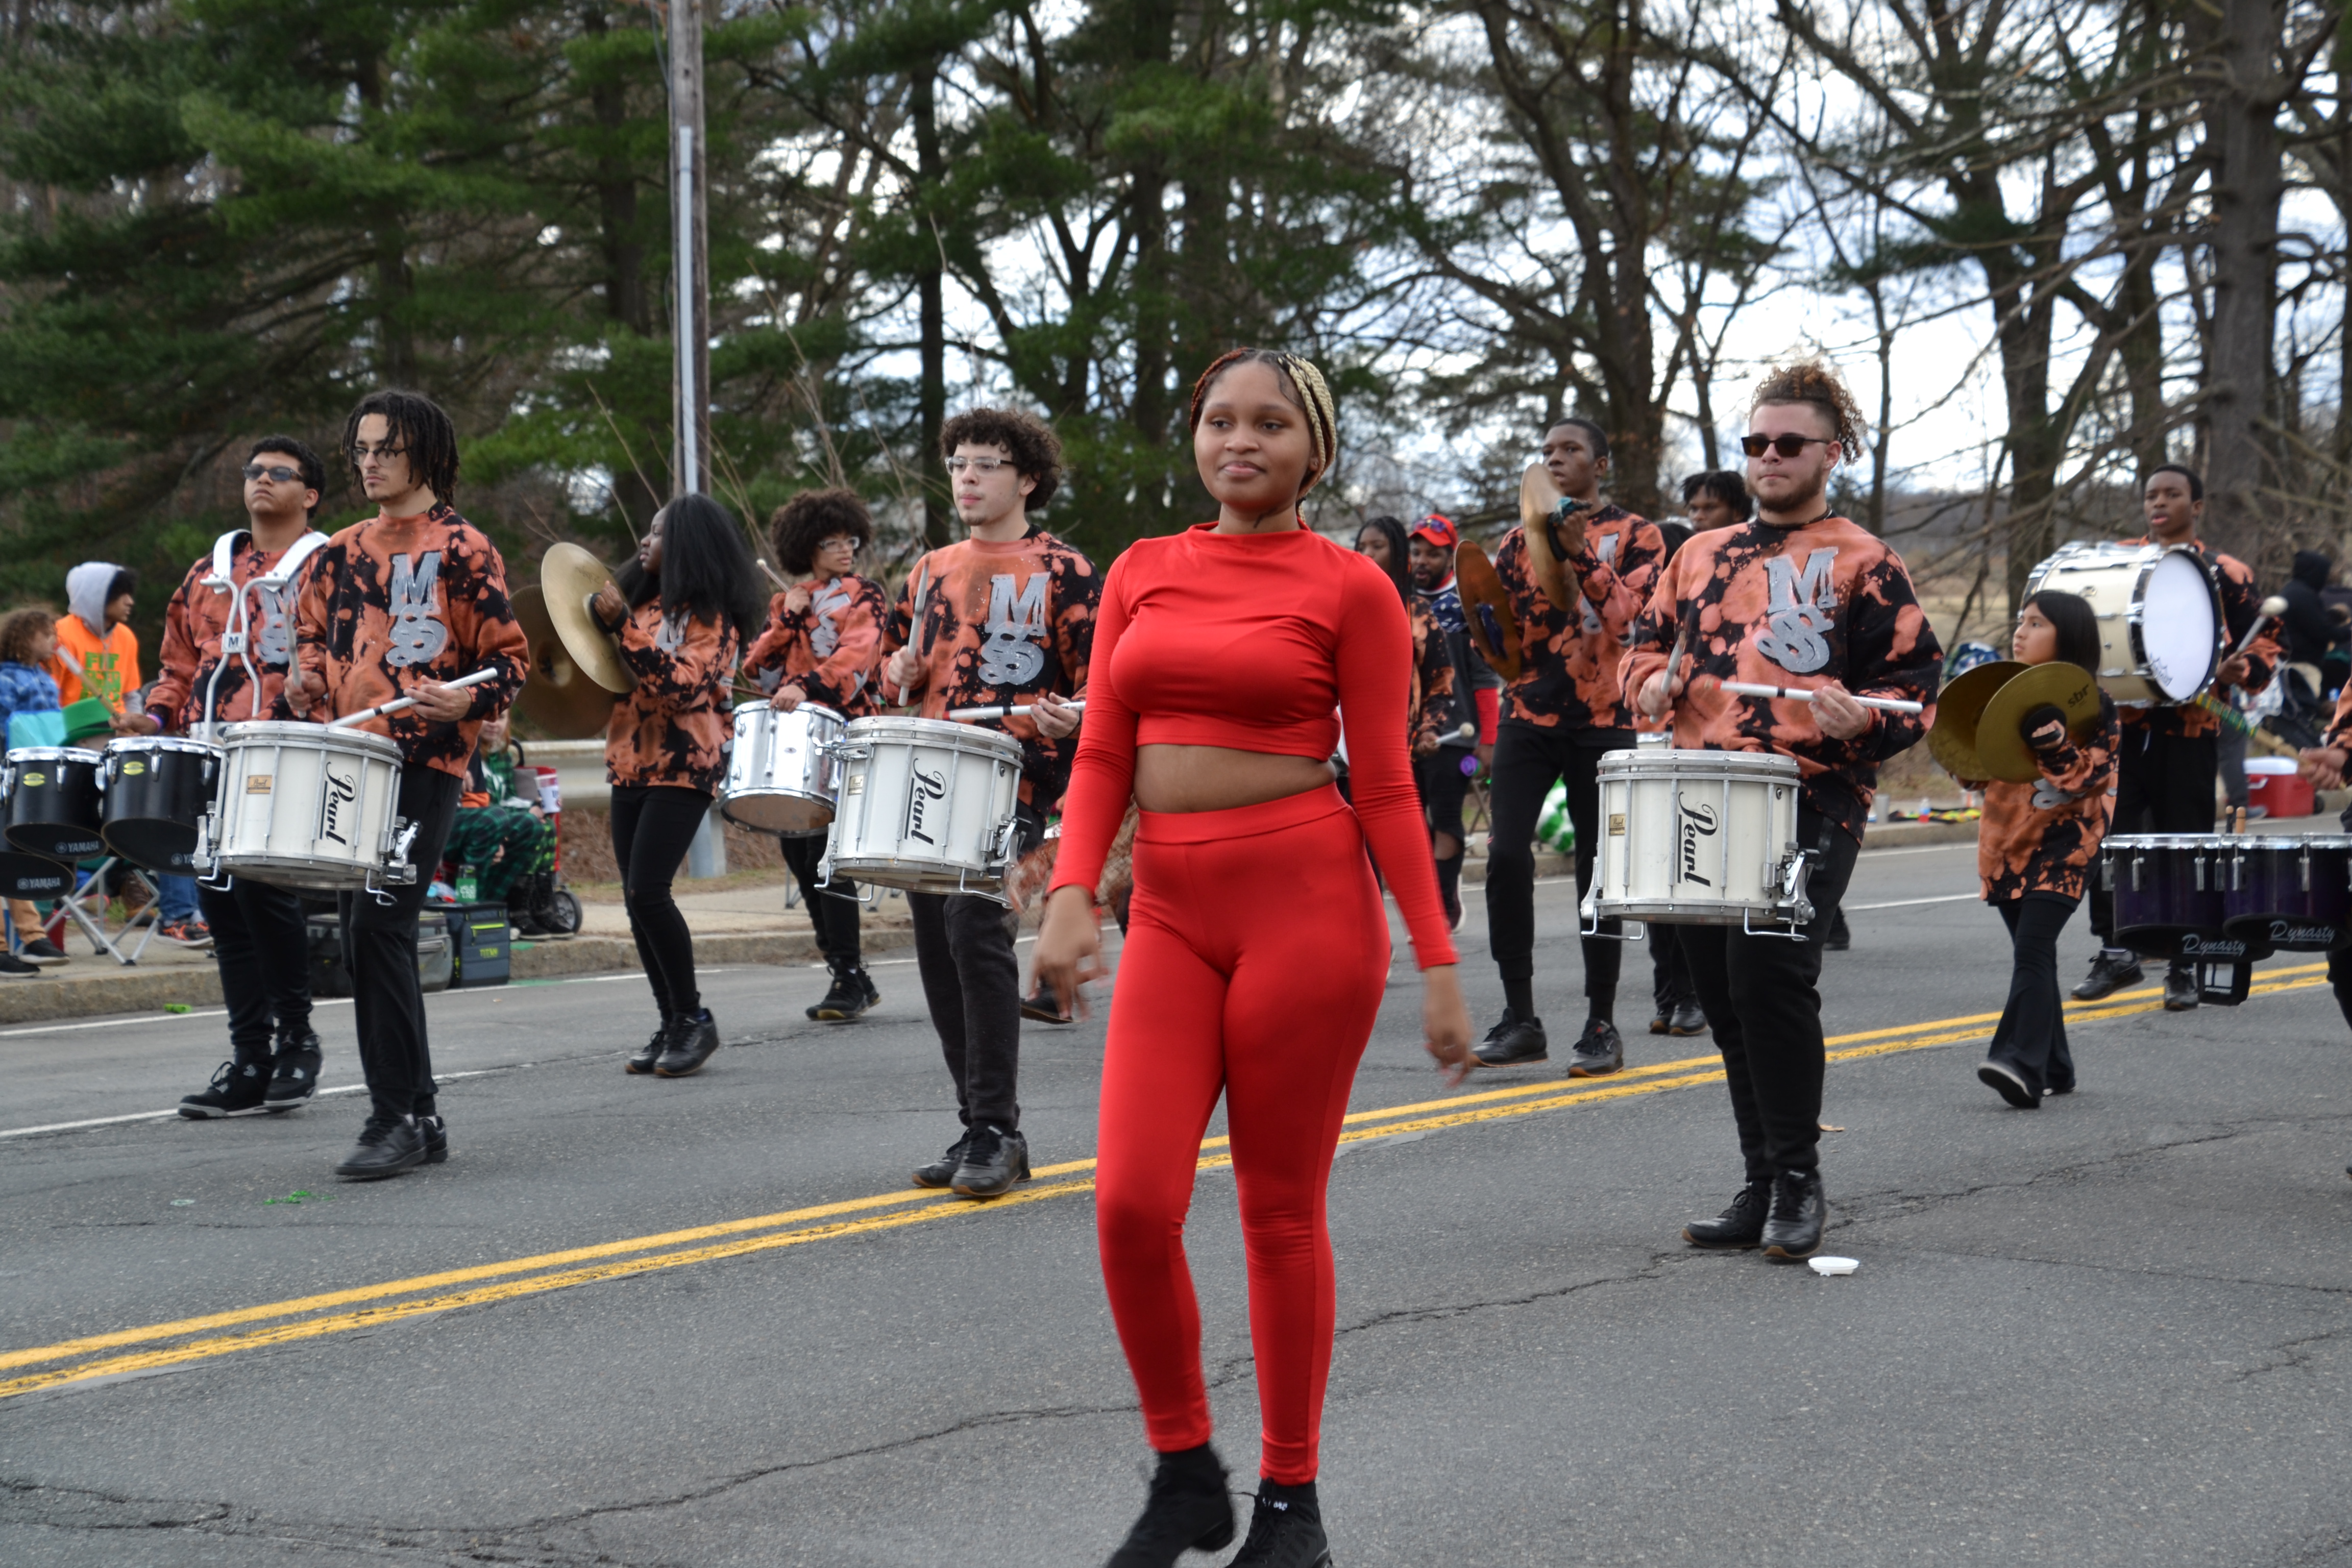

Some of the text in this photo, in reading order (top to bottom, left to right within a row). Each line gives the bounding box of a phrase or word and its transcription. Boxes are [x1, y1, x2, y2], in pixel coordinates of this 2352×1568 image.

[229, 636, 239, 647] M
[85, 651, 119, 670] FIT
[2068, 683, 2089, 708] sbr
[326, 762, 356, 846] Pearl
[911, 758, 946, 846] Pearl
[67, 840, 100, 853] YAMAHA
[1678, 791, 1718, 888] Pearl
[29, 876, 61, 889] YAMAHA
[2269, 920, 2335, 943] Dynasty
[2182, 934, 2246, 956] Dynasty
